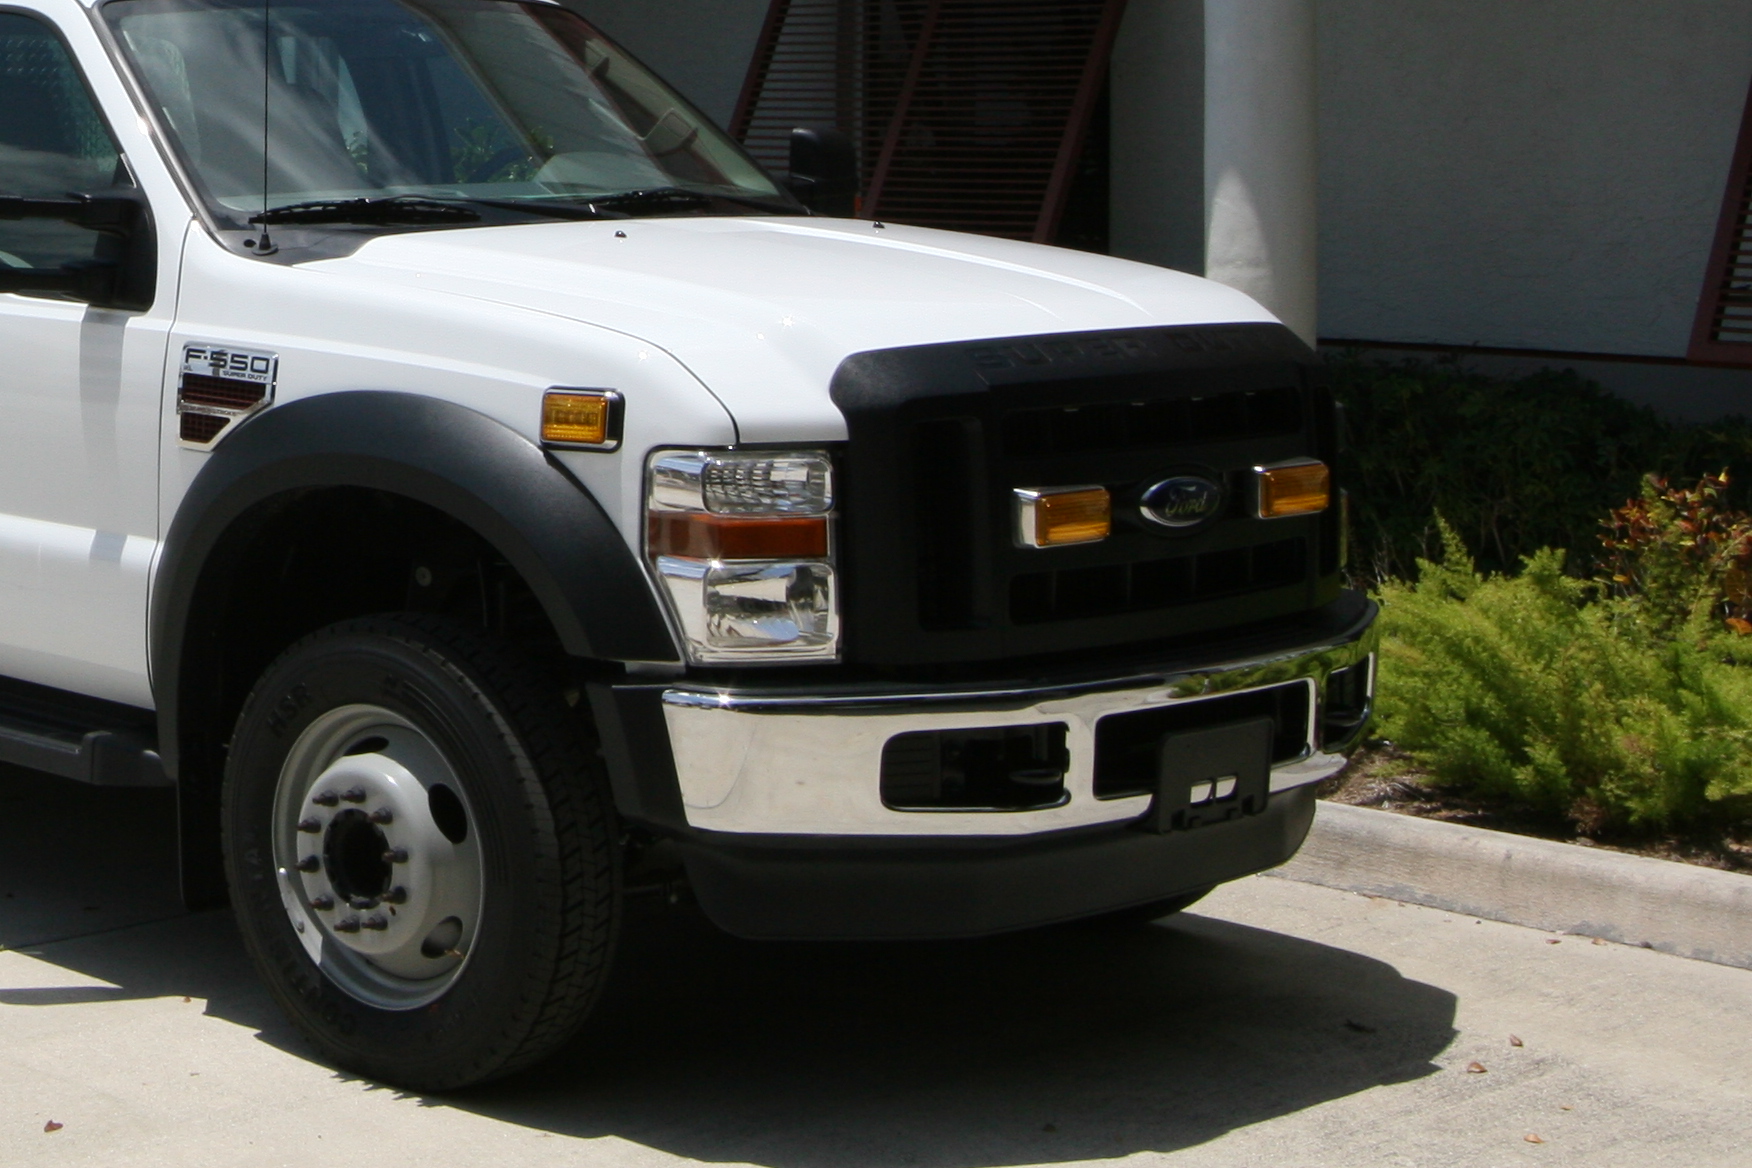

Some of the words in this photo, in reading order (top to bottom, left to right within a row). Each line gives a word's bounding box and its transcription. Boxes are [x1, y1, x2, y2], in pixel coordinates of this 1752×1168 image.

[186, 348, 270, 374] F-550
[222, 370, 247, 379] SUPER
[248, 373, 268, 382] DUTY
[1165, 485, 1207, 517] Ford
